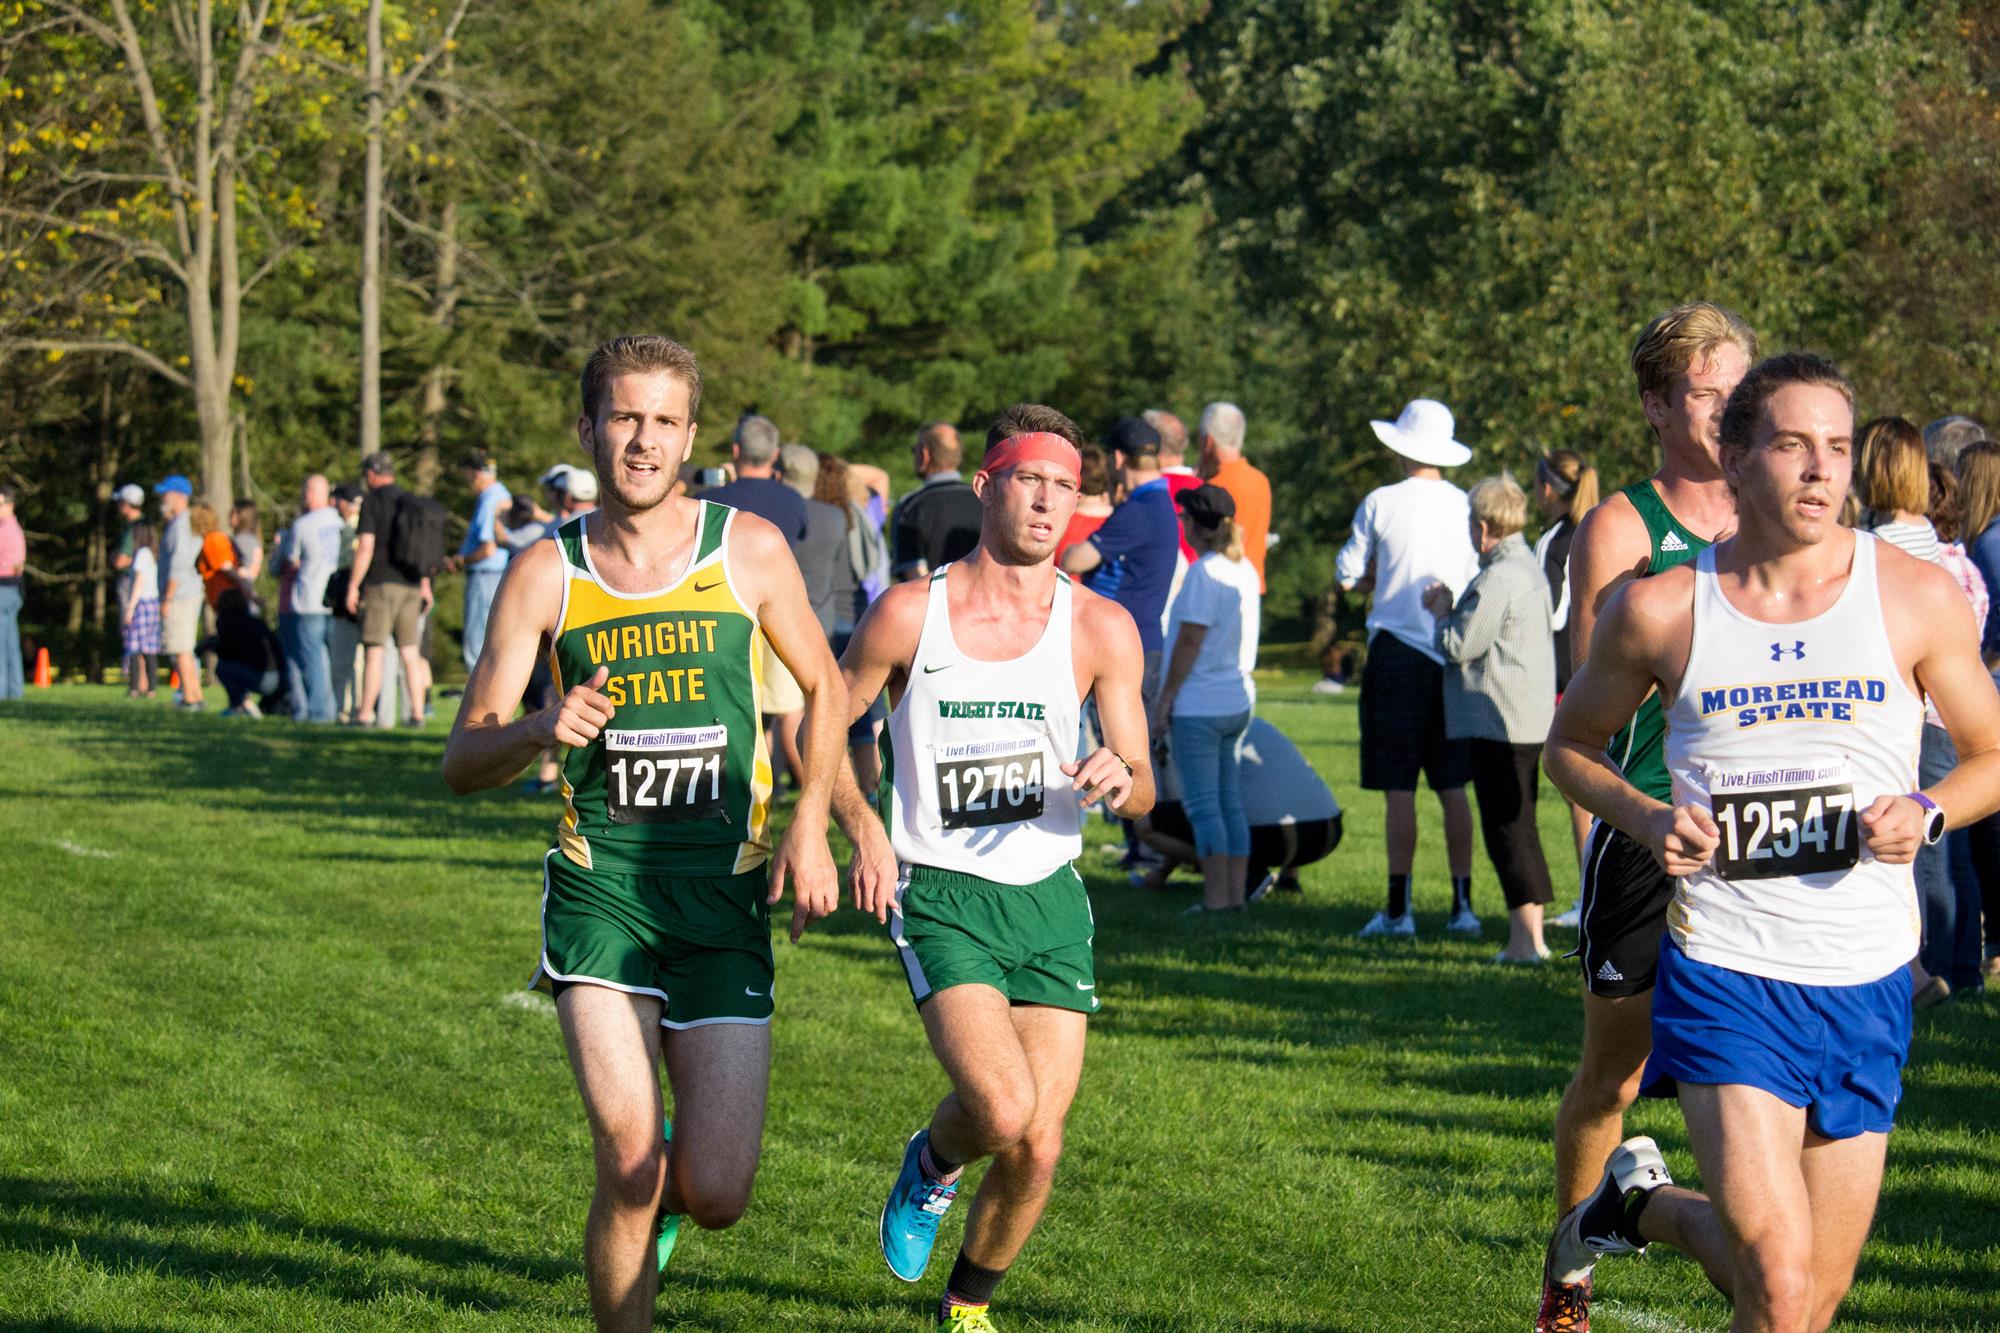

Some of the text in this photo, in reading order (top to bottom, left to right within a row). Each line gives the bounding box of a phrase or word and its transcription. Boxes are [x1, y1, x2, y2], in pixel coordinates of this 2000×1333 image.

[1661, 543, 1688, 551] adidas
[585, 619, 719, 665] WRIGHT
[606, 668, 706, 706] STATE
[1700, 677, 1887, 715] MOREHEAD
[938, 700, 1046, 720] WRIGHT STATE
[1737, 701, 1853, 728] STATE
[611, 754, 720, 807] 12771
[942, 758, 1044, 812] 12764
[1717, 792, 1853, 861] 12547
[1597, 973, 1623, 981] adidas
